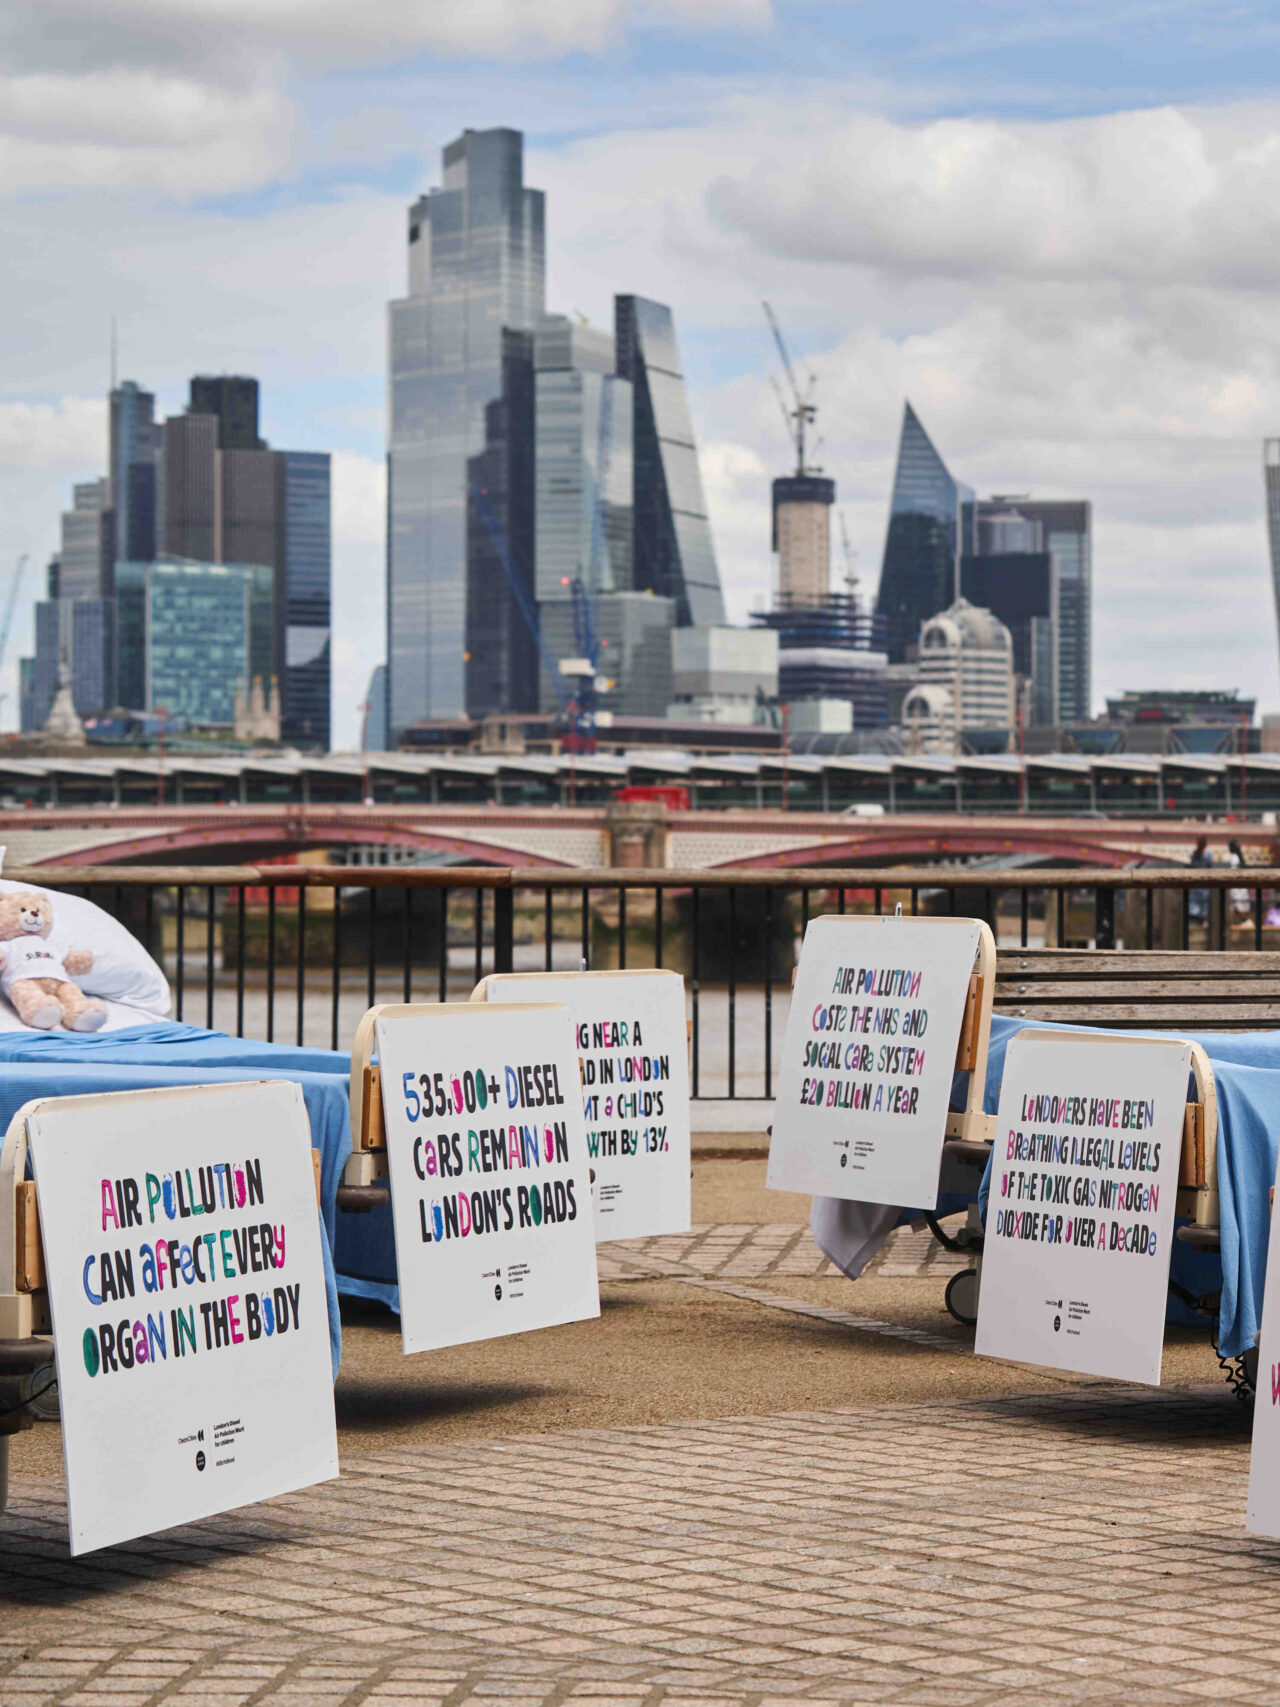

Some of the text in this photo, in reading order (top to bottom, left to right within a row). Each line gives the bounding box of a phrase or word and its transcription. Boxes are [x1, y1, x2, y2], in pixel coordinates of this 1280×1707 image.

[832, 966, 922, 999] AIR POLLUTION
[593, 1021, 629, 1049] NEAR
[633, 1021, 642, 1046] A
[812, 1003, 848, 1032] COSTS
[849, 1005, 873, 1033] THE
[873, 1007, 900, 1036] NHS
[600, 1058, 614, 1084] IN
[617, 1055, 669, 1082] LONDON
[877, 1044, 925, 1076] SYSTEM
[402, 1063, 564, 1123] 535,000+ DIESEL
[617, 1089, 664, 1119] CHILD'S
[800, 1077, 824, 1106] £20
[826, 1079, 872, 1110] BILLION
[873, 1084, 883, 1112] A
[1021, 1093, 1086, 1126] LONDONERS
[1121, 1099, 1155, 1130] BEEN
[467, 1124, 540, 1173] REMAIN
[543, 1121, 569, 1164] ON
[643, 1126, 669, 1153] 13%
[1070, 1136, 1115, 1171] ILLEGAL
[101, 1158, 264, 1232] AIR POLLUTION
[1001, 1170, 1016, 1199] OF
[1017, 1171, 1038, 1202] THE
[1040, 1174, 1072, 1205] TOXIC
[1073, 1177, 1097, 1208] GAS
[419, 1179, 577, 1243] LONDON'S ROADS
[996, 1209, 1039, 1241] DIOXIDE
[1040, 1213, 1063, 1244] FOR
[1064, 1216, 1096, 1249] OVER
[1097, 1222, 1106, 1251] A
[83, 1248, 135, 1305] CAN
[170, 1304, 197, 1358] IN
[200, 1294, 244, 1351] THE
[245, 1283, 301, 1340] BODY
